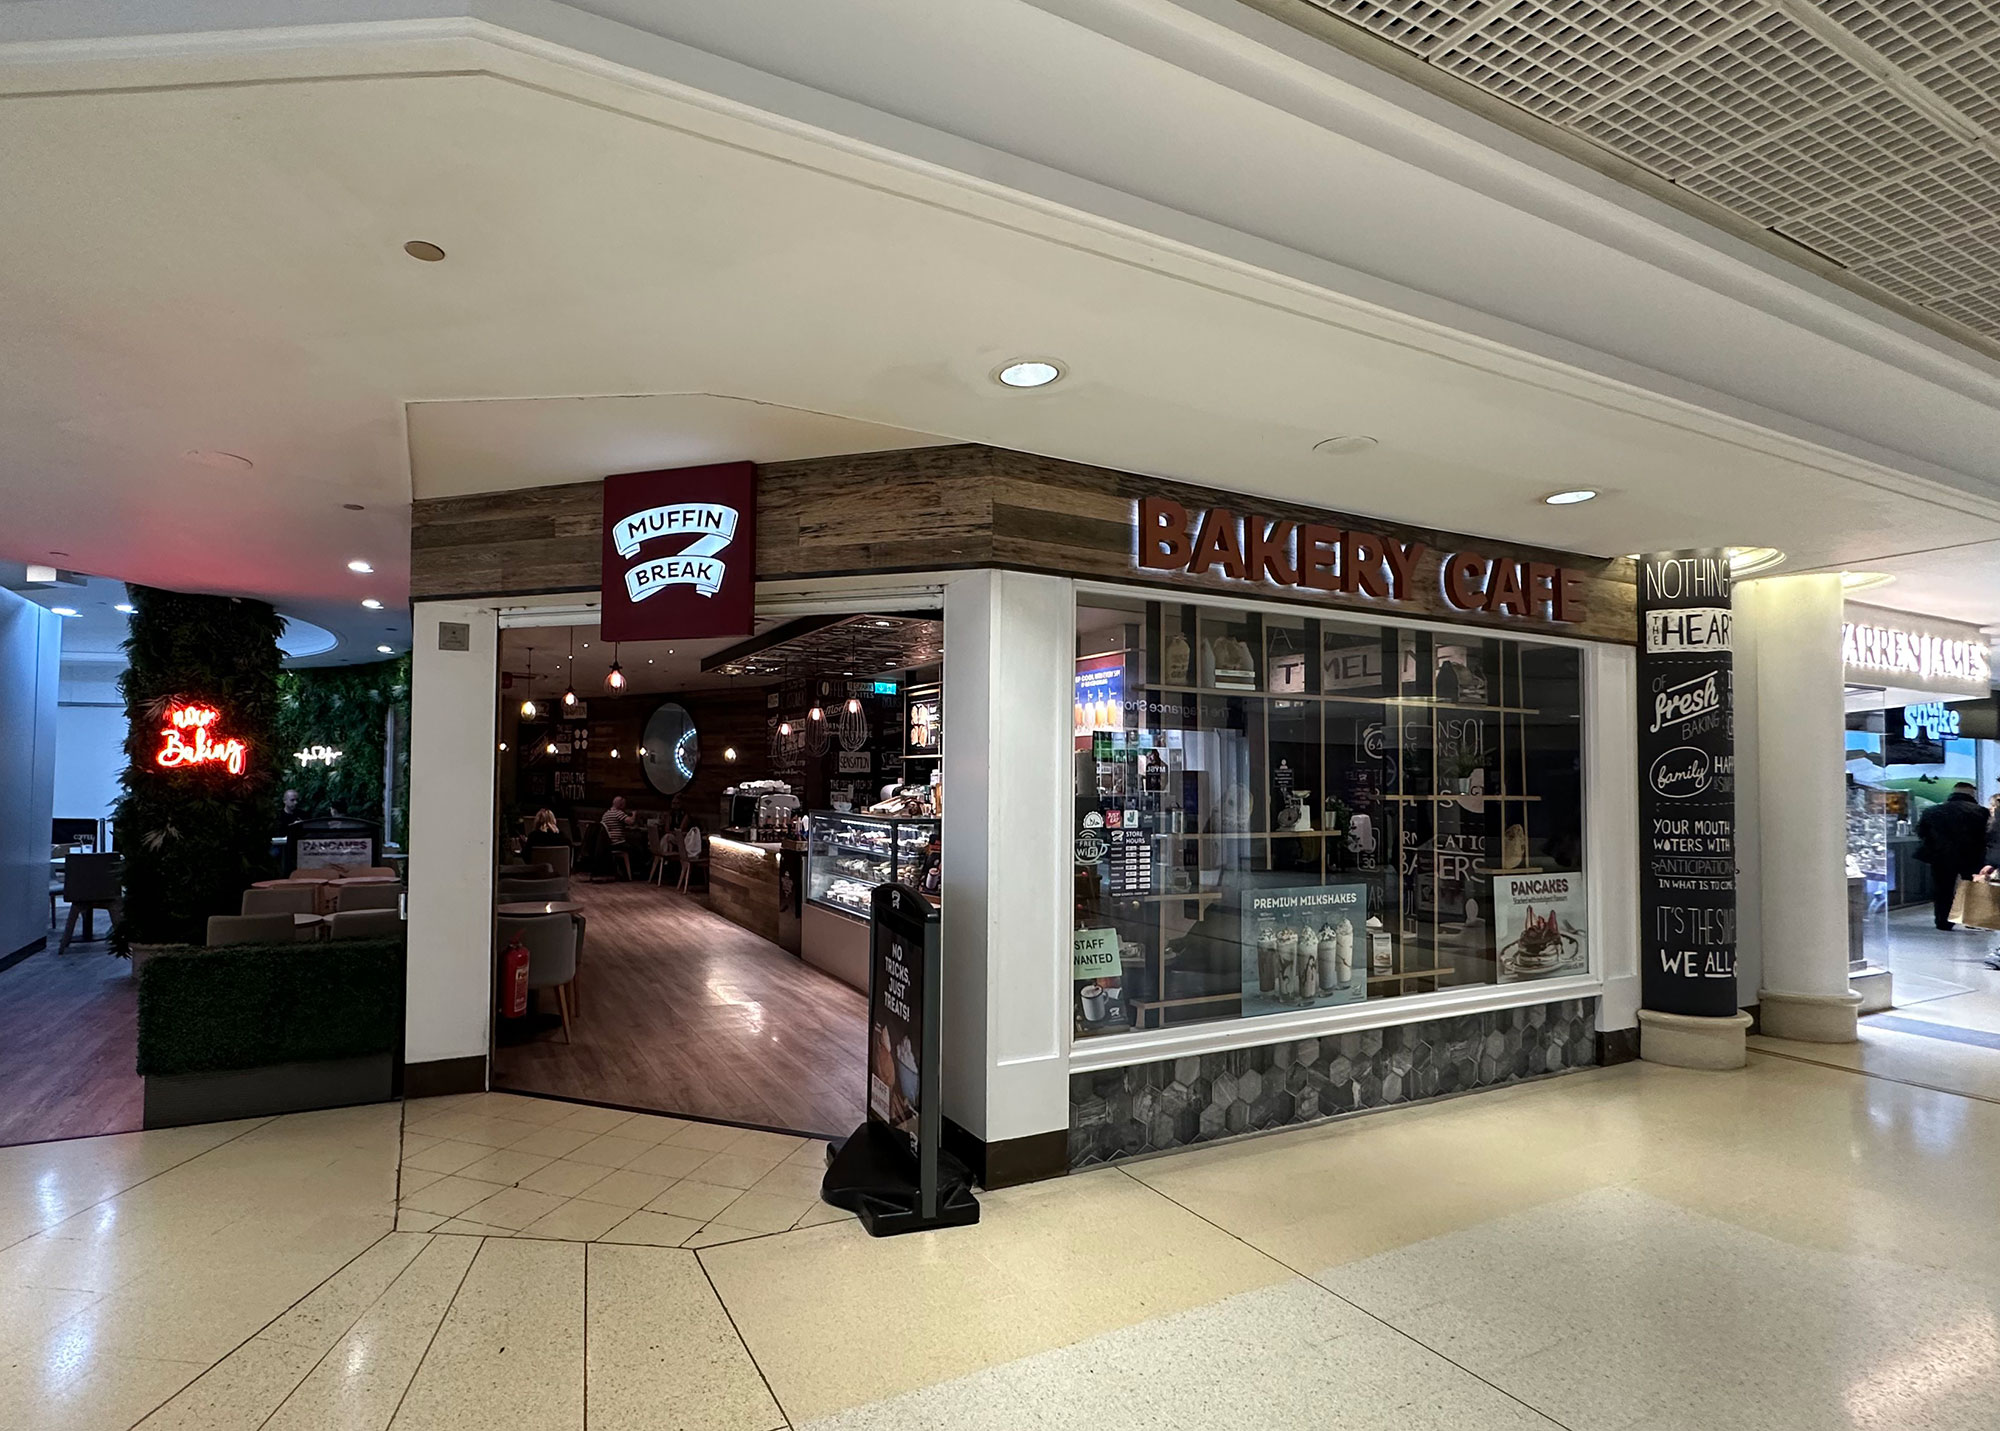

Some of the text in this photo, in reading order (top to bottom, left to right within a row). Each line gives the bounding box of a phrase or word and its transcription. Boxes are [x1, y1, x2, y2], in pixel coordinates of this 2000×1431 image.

[627, 509, 723, 540] MUFFIN
[635, 561, 713, 587] BREAK
[1138, 499, 1588, 622] BAKERY CAFE
[1646, 558, 1730, 600] NOTHING
[1661, 613, 1733, 646] HEAR
[1652, 673, 1667, 693] OF
[1650, 676, 1719, 733] fresh
[1681, 711, 1720, 741] BAKING
[158, 727, 245, 774] Baking
[1657, 756, 1707, 789] family
[1653, 819, 1730, 835] YOUR MOUTH
[1077, 847, 1098, 857] WiFi
[1707, 838, 1730, 852] WITH
[1511, 878, 1569, 896] PANCAKES
[1659, 879, 1670, 888] IN
[1672, 880, 1697, 889] WHAT
[1699, 880, 1709, 890] IS
[1254, 892, 1357, 909] PREMIUM MILKSHAKES
[1656, 906, 1685, 943] IT'S
[1688, 907, 1714, 945] THE
[892, 943, 903, 961] NO
[1074, 938, 1105, 951] STAFF
[885, 955, 911, 987] TRICKS,
[1074, 952, 1113, 966] WANTED
[1660, 949, 1698, 978] WE
[1704, 952, 1732, 974] ALL
[888, 980, 906, 1002] JUST
[884, 990, 910, 1022] TREATS!
